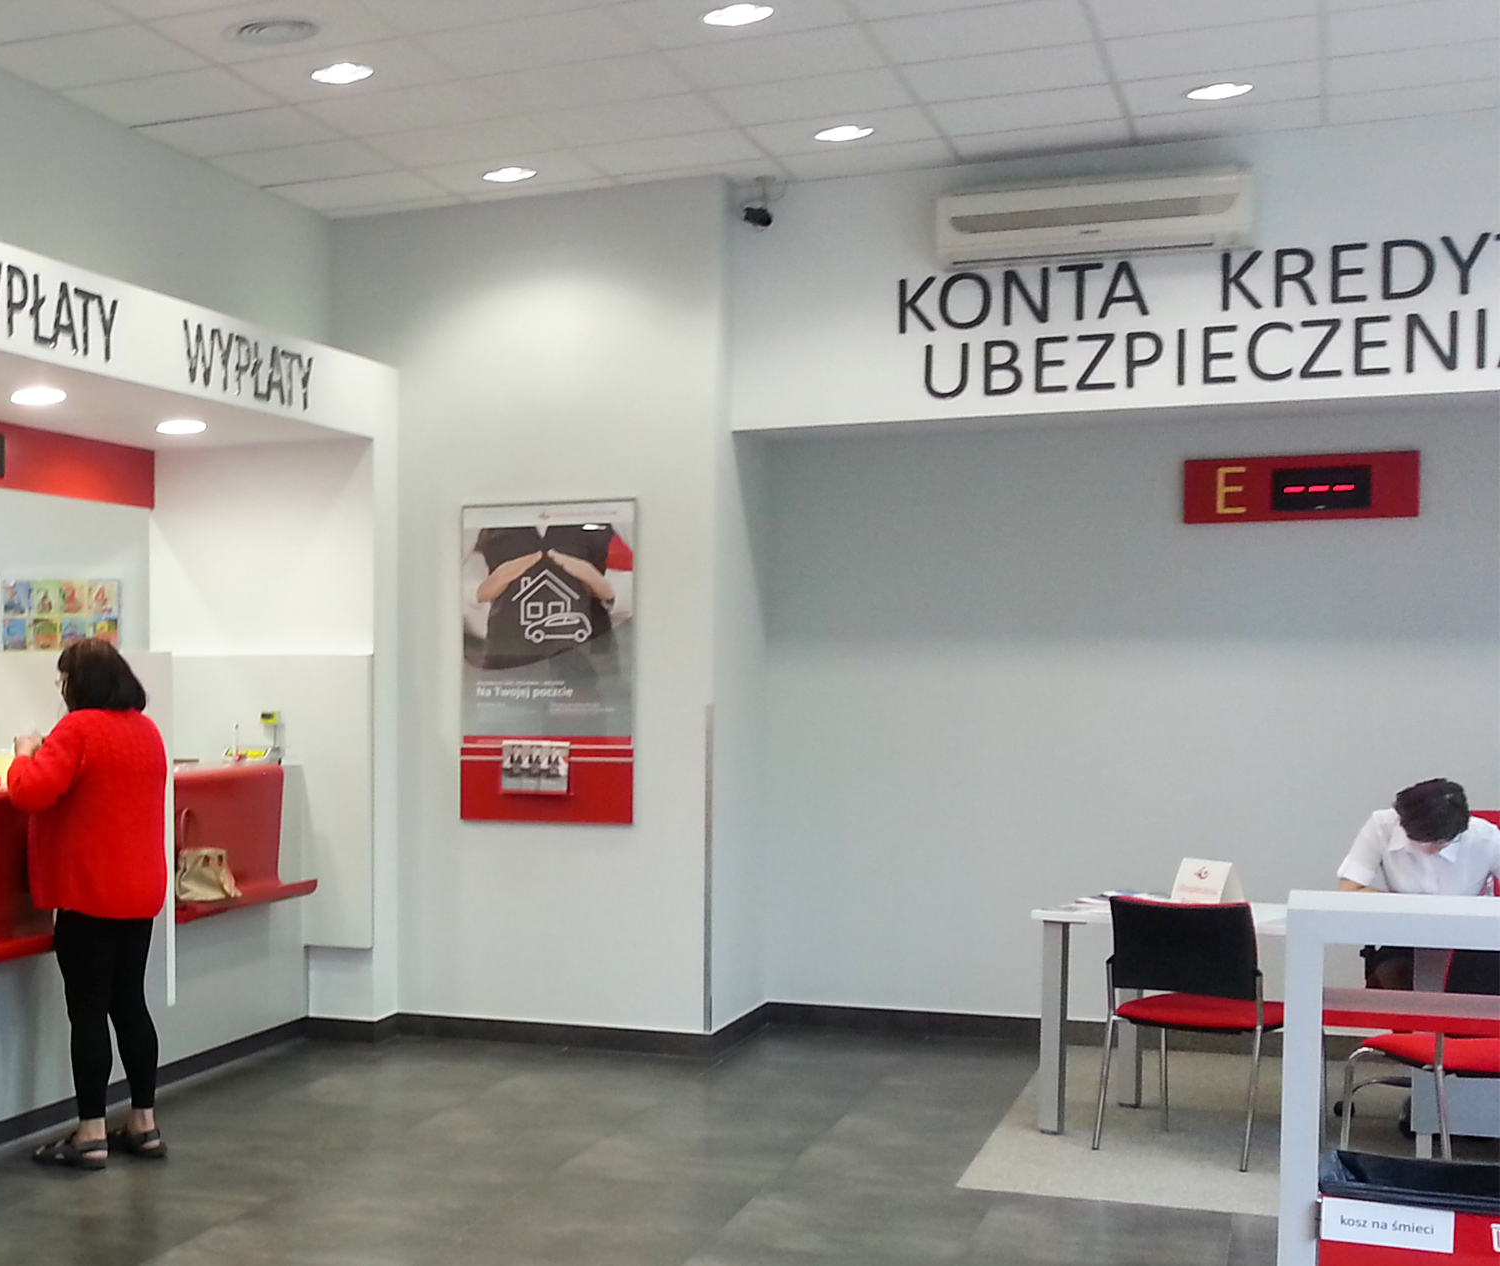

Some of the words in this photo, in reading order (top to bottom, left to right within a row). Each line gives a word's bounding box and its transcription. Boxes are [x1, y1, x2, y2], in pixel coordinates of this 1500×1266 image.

[898, 261, 1149, 334] KONTA
[1221, 229, 1500, 311] KREDY
[183, 319, 313, 411] WYPŁATY
[924, 308, 1500, 399] UBEZPIECZENI
[1216, 466, 1247, 515] E
[476, 687, 491, 697] Na
[494, 686, 530, 699] Twojej
[1340, 1215, 1367, 1228] kosz
[1372, 1221, 1388, 1230] na
[1392, 1220, 1434, 1235] śmieci
